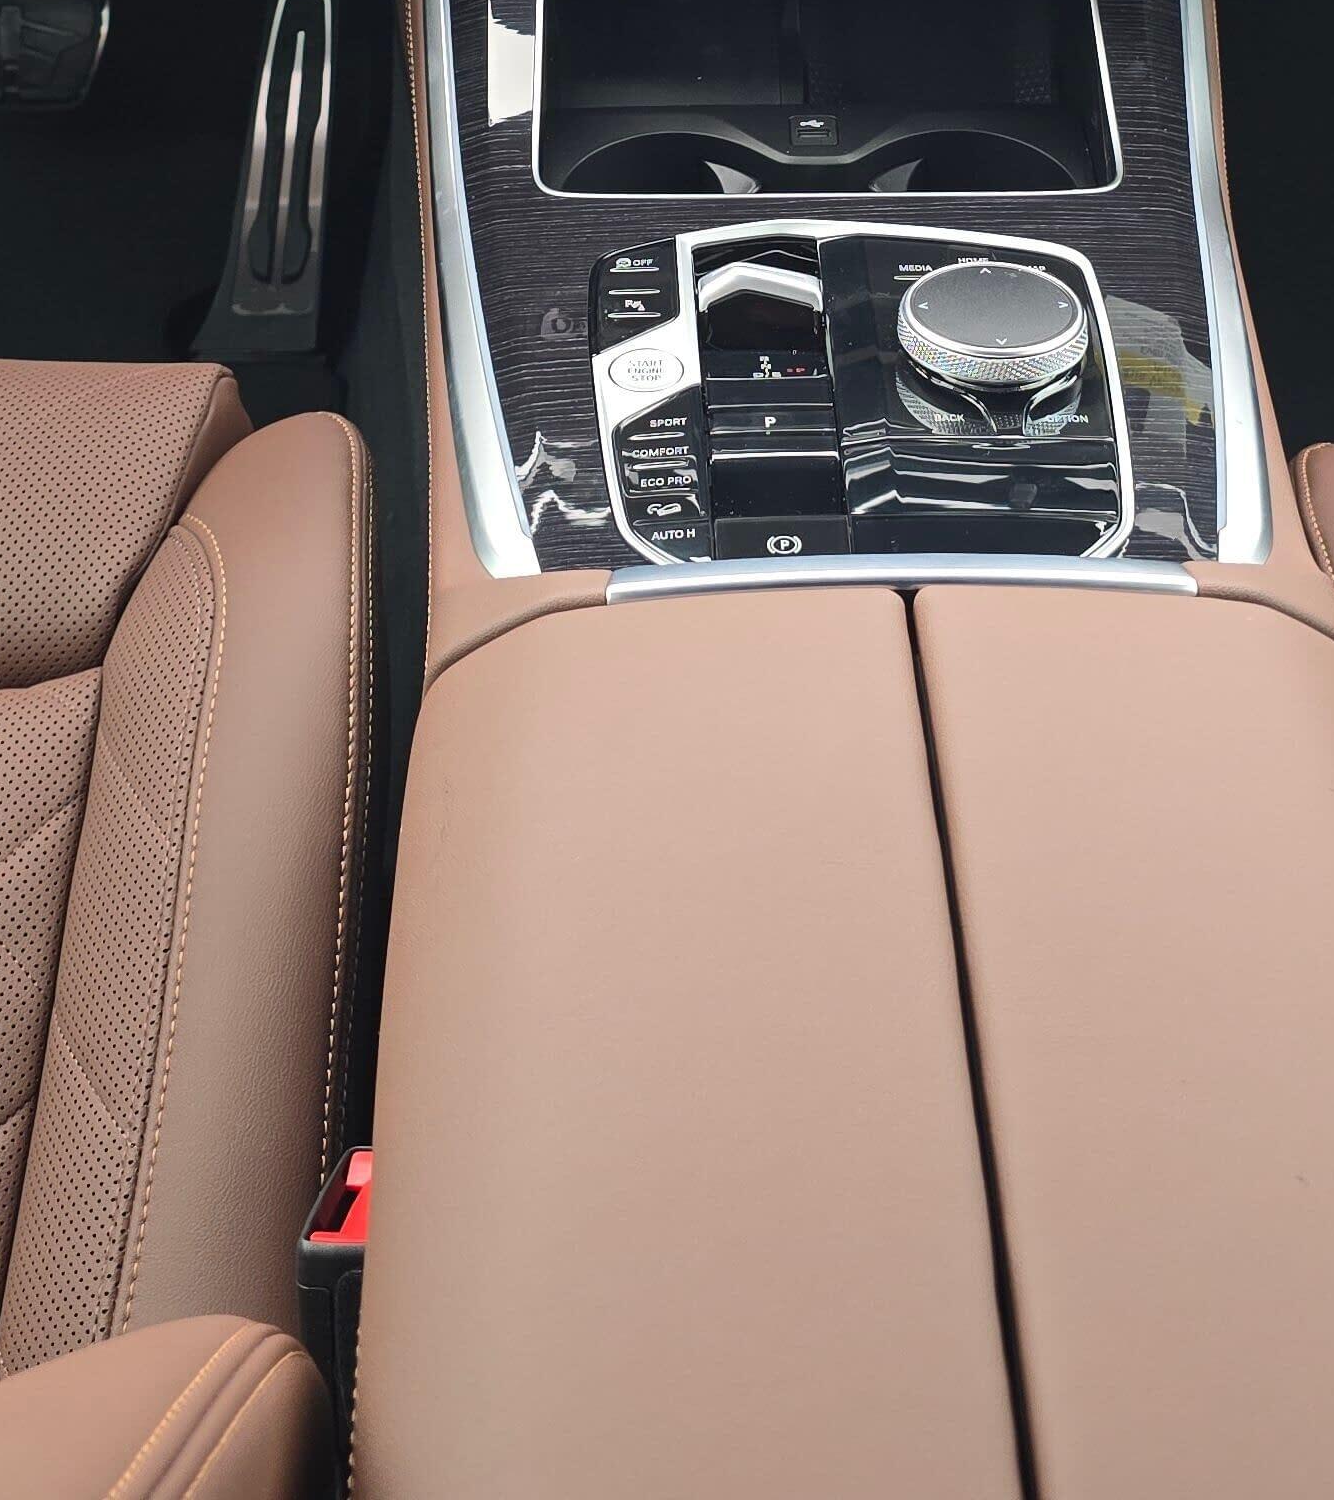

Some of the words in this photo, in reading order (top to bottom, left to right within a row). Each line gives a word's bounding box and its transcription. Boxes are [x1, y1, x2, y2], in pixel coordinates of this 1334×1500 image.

[632, 258, 654, 267] OFF
[898, 263, 933, 272] MEDIA
[649, 417, 687, 428] SPORT
[764, 416, 777, 428] P
[934, 413, 966, 423] BACK
[1046, 413, 1089, 423] OPTION
[632, 446, 689, 457] COMFORT
[640, 477, 665, 488] ECO
[667, 475, 692, 487] PRO
[651, 529, 684, 541] AUTO
[686, 528, 696, 539] H
